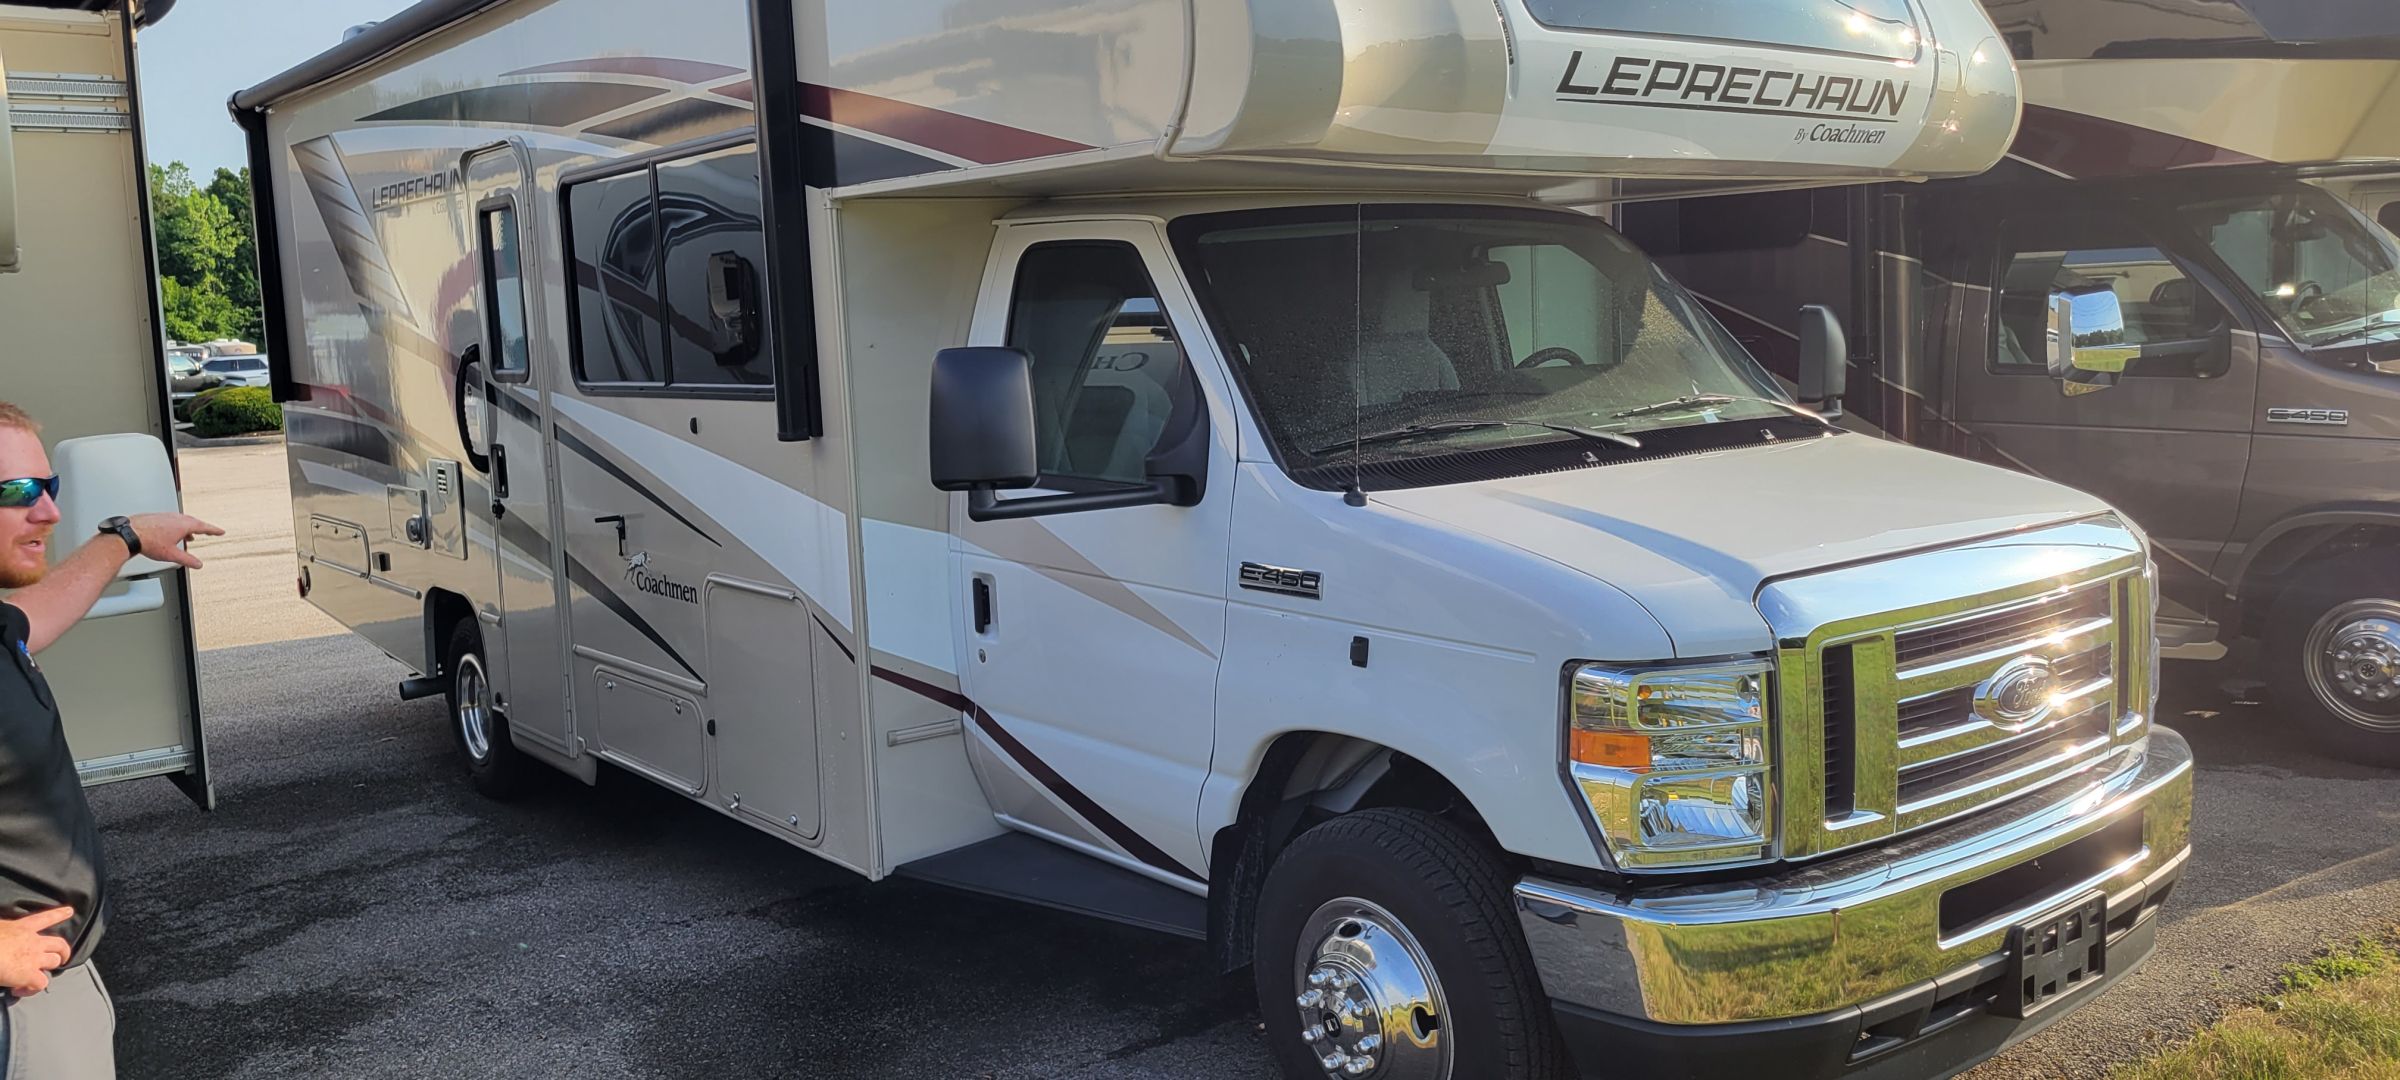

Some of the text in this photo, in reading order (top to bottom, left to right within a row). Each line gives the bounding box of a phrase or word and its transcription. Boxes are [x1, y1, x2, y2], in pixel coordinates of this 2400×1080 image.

[1556, 50, 1910, 116] LEPRECHAUN
[1794, 123, 1886, 144] By Coachmen
[372, 167, 463, 209] LEPRECHAUN
[2269, 409, 2346, 421] E-450
[636, 571, 698, 604] Coachmen
[1240, 561, 1321, 589] E-450
